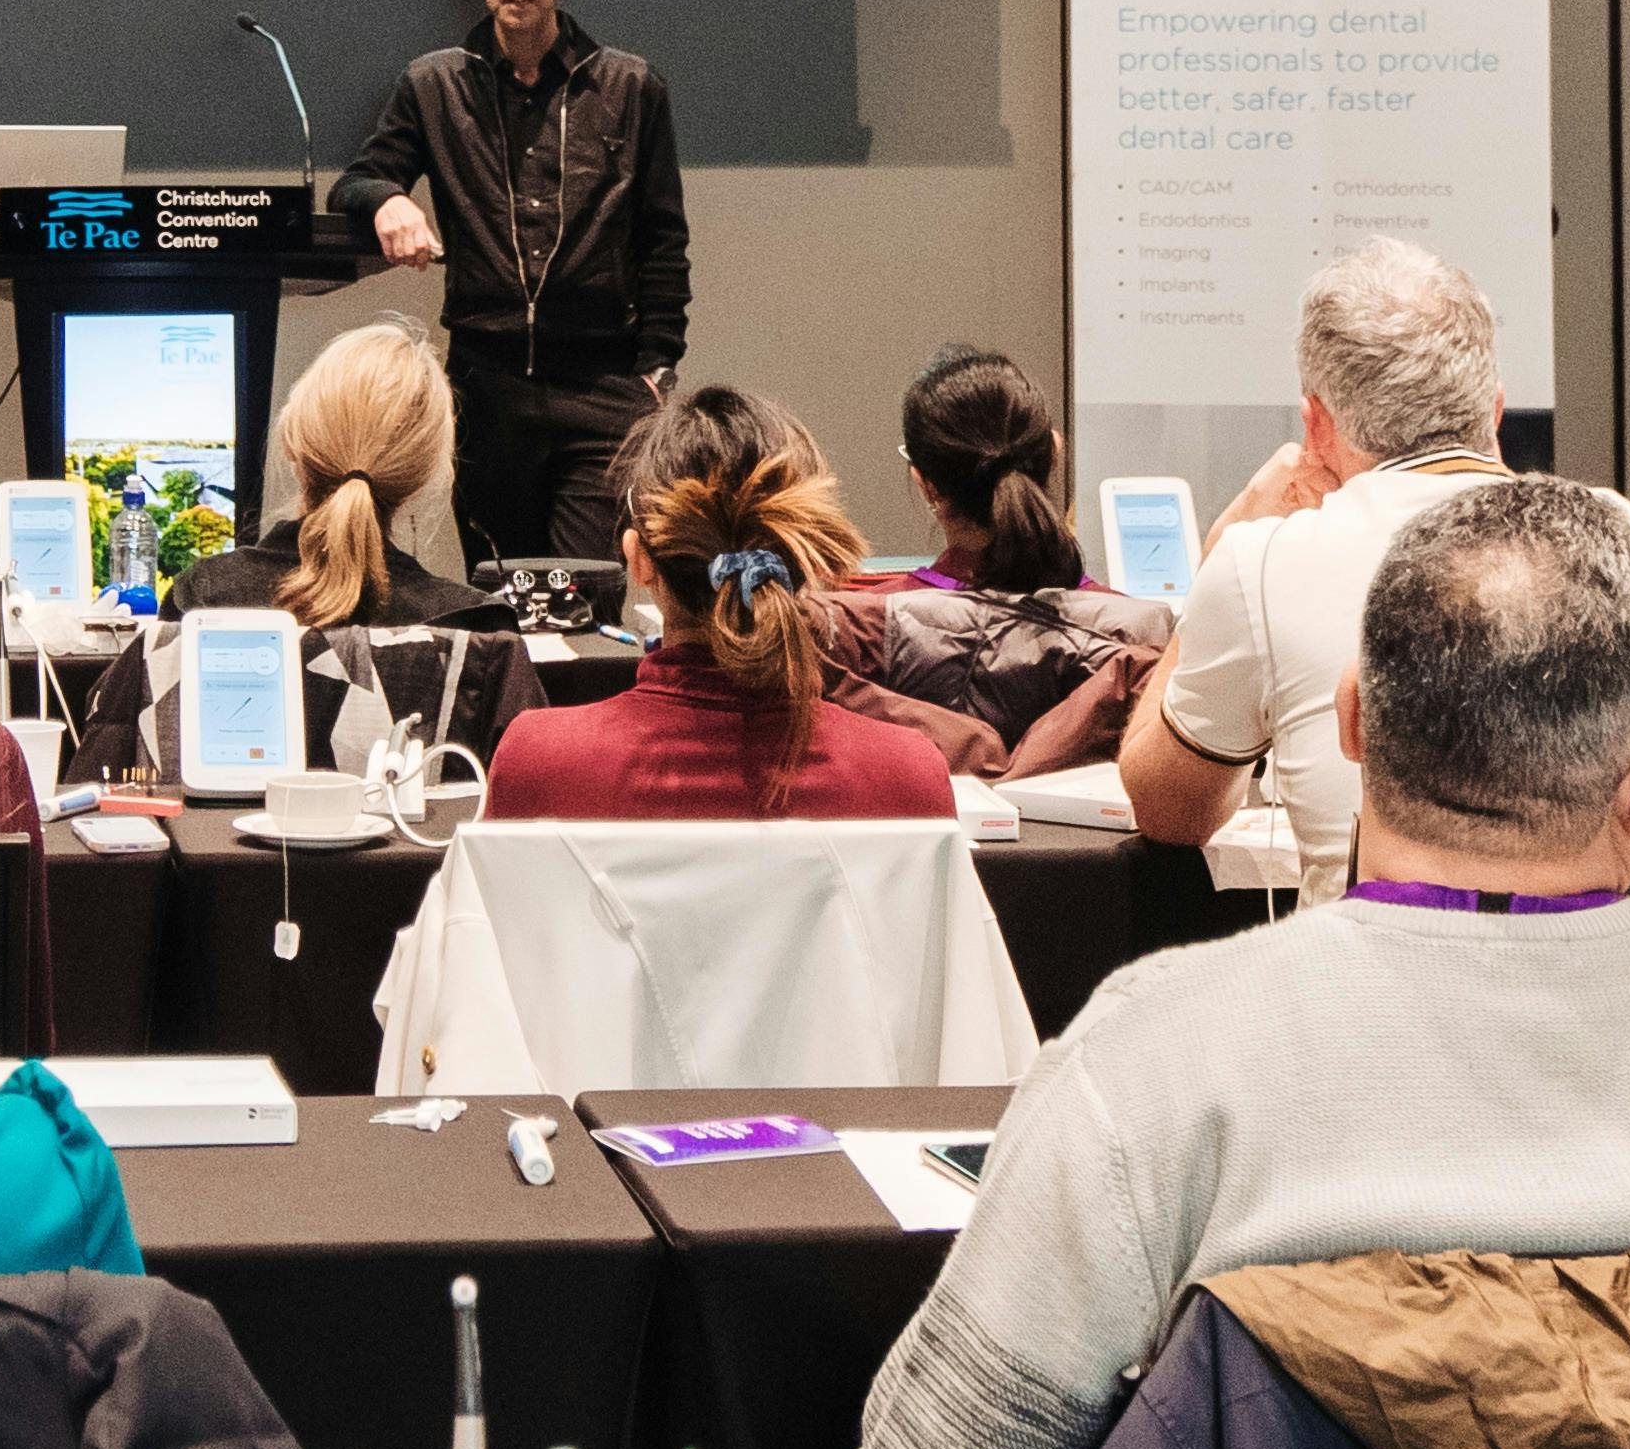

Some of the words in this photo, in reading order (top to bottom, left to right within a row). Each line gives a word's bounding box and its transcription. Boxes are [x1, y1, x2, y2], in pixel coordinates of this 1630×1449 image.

[1118, 7, 1317, 36] Empowering
[1329, 7, 1427, 33] dental
[1118, 49, 1323, 77] professionals
[1335, 51, 1367, 73] to
[1378, 49, 1499, 77] provide
[1118, 88, 1220, 114] better,
[1232, 88, 1316, 114] safer,
[1328, 88, 1415, 112] faster
[1118, 127, 1214, 150] dental
[1226, 132, 1293, 150] care
[1138, 179, 1233, 197] CAD/CAM
[1333, 180, 1453, 197] Orthodontics
[157, 190, 271, 207] Christchurch
[157, 211, 258, 228] Convention
[1138, 211, 1251, 228] Endodontics
[1333, 212, 1429, 230] Preventive
[41, 222, 78, 249] Te
[84, 222, 139, 249] Pae
[157, 233, 218, 249] Centre
[1139, 245, 1211, 263] Imaging
[1139, 277, 1215, 295] Implants
[1139, 310, 1244, 327] Instruments
[184, 347, 221, 366] Pae
